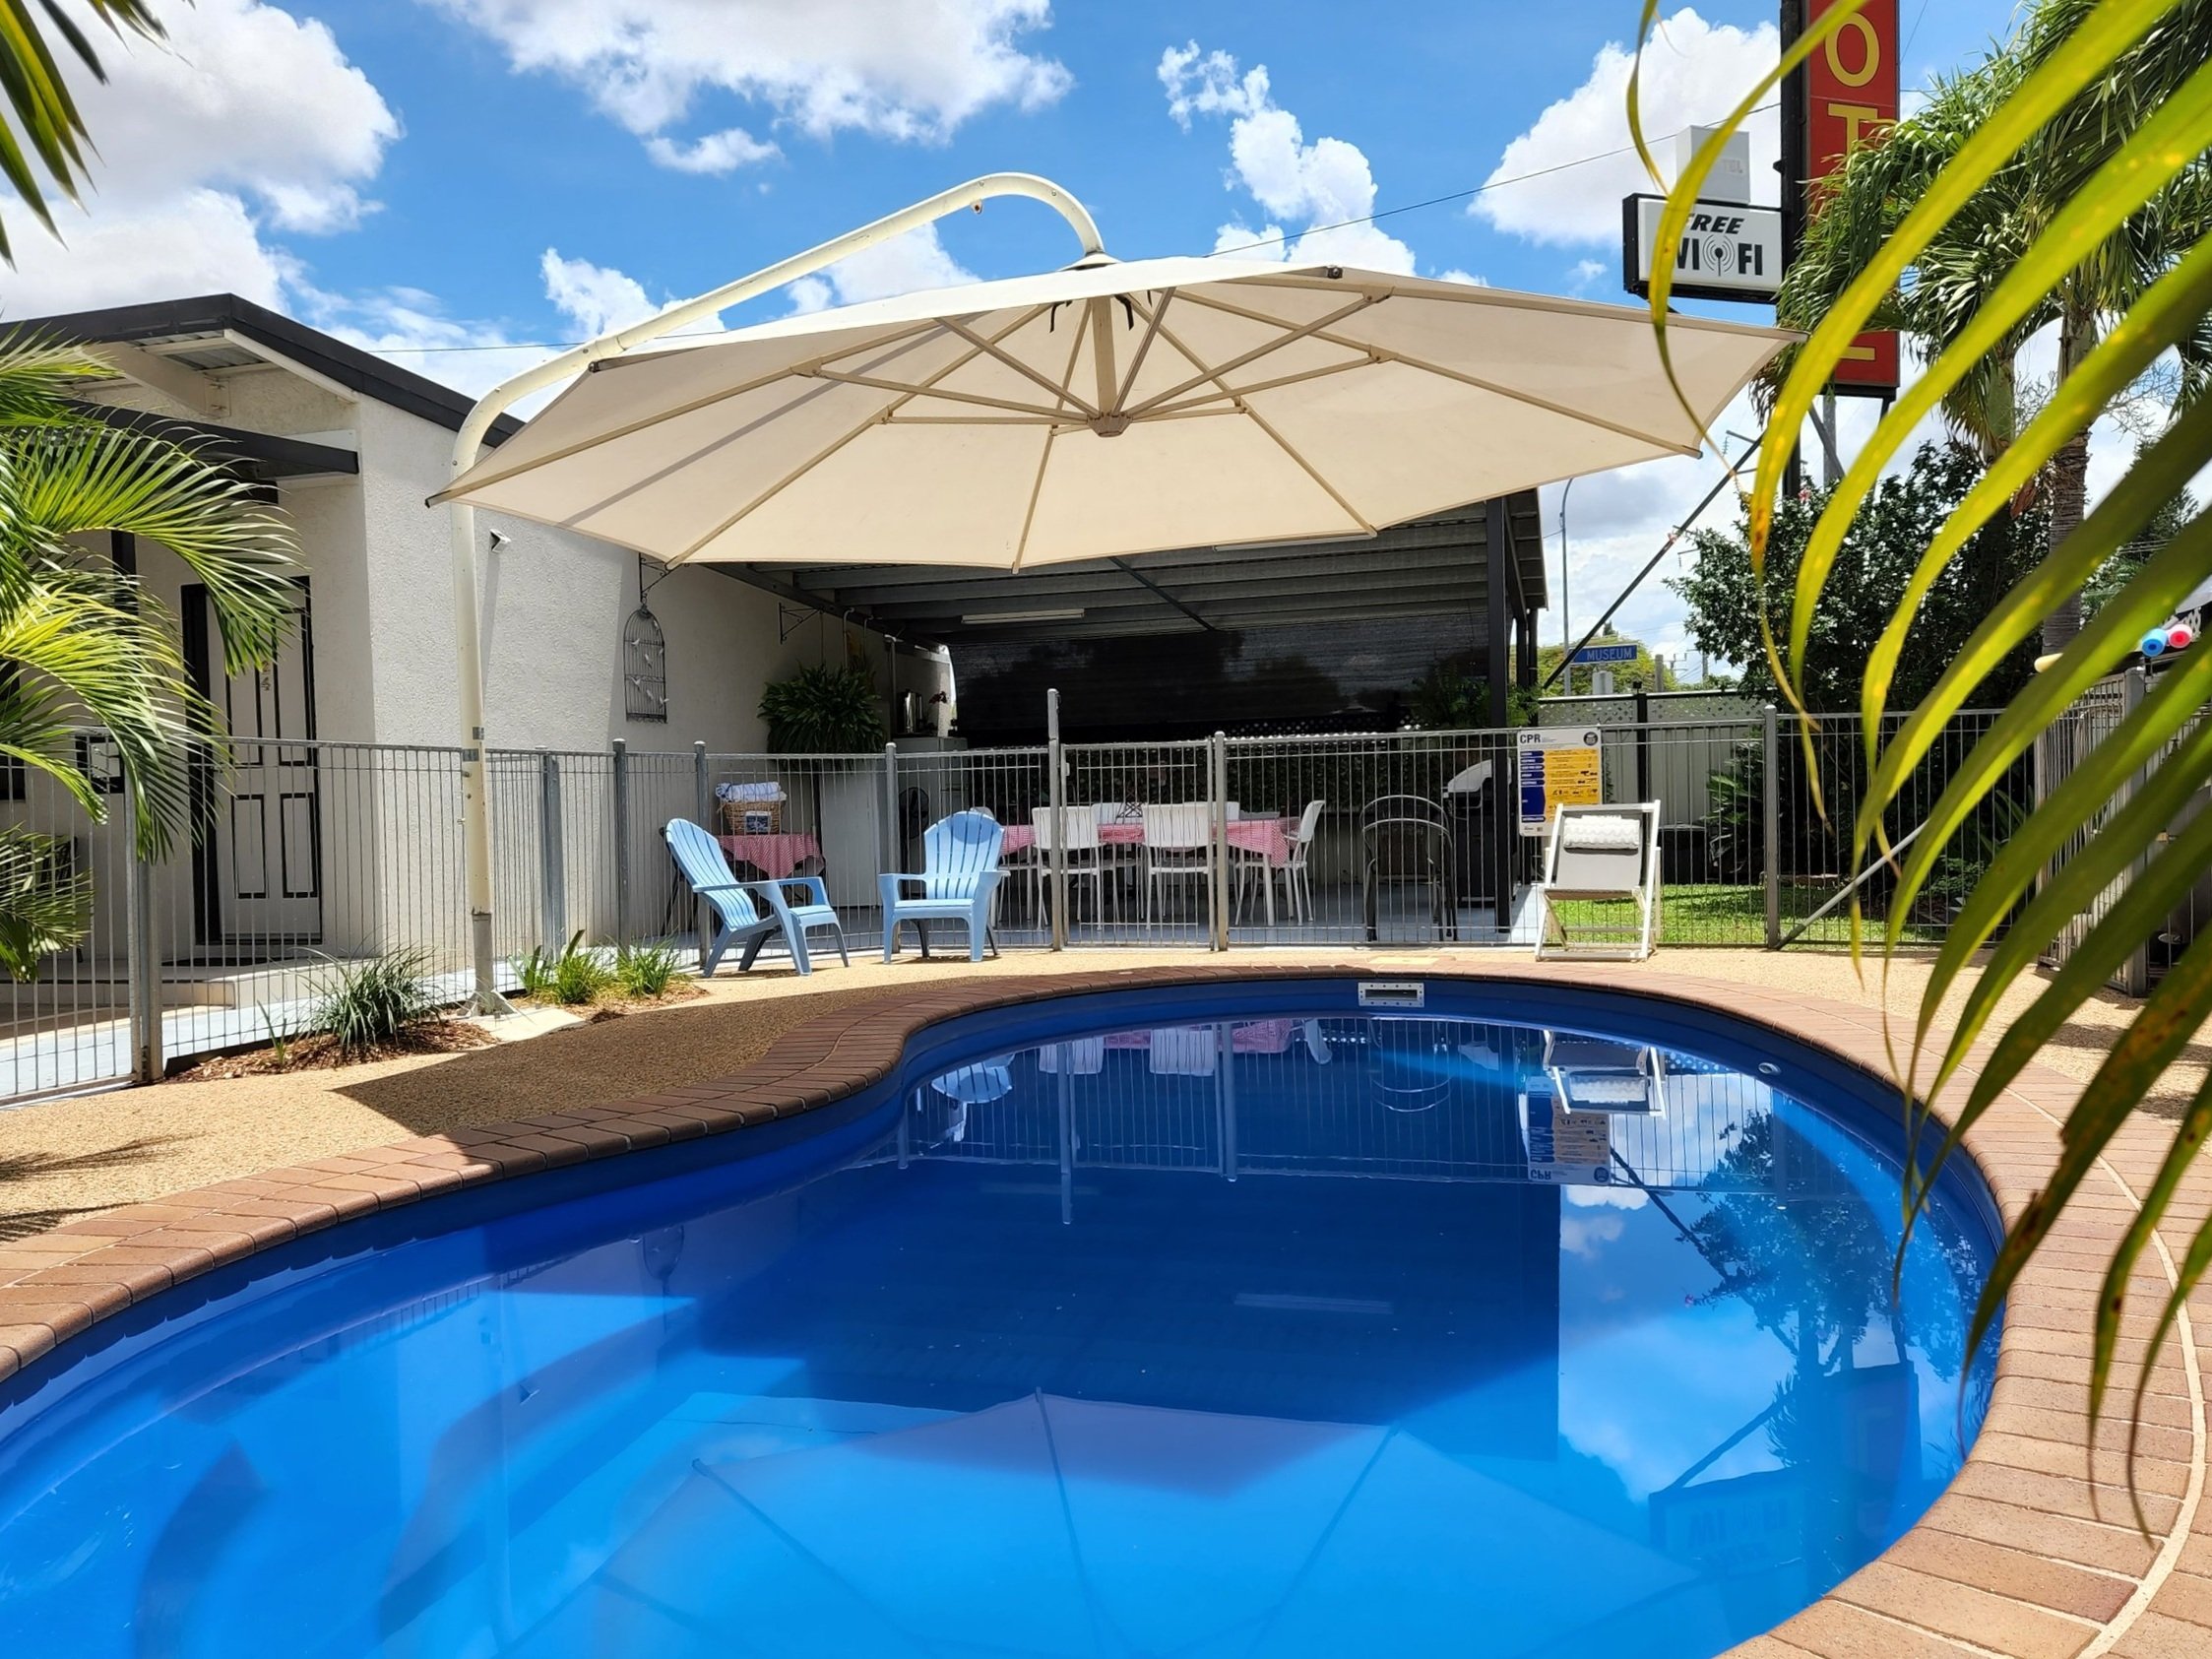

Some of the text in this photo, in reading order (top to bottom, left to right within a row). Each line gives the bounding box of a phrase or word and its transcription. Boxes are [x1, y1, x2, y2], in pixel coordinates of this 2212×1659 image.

[1687, 213, 1744, 234] REE
[1738, 242, 1762, 276] FI
[1587, 648, 1632, 661] MUSEUM
[1520, 733, 1541, 743] CPR
